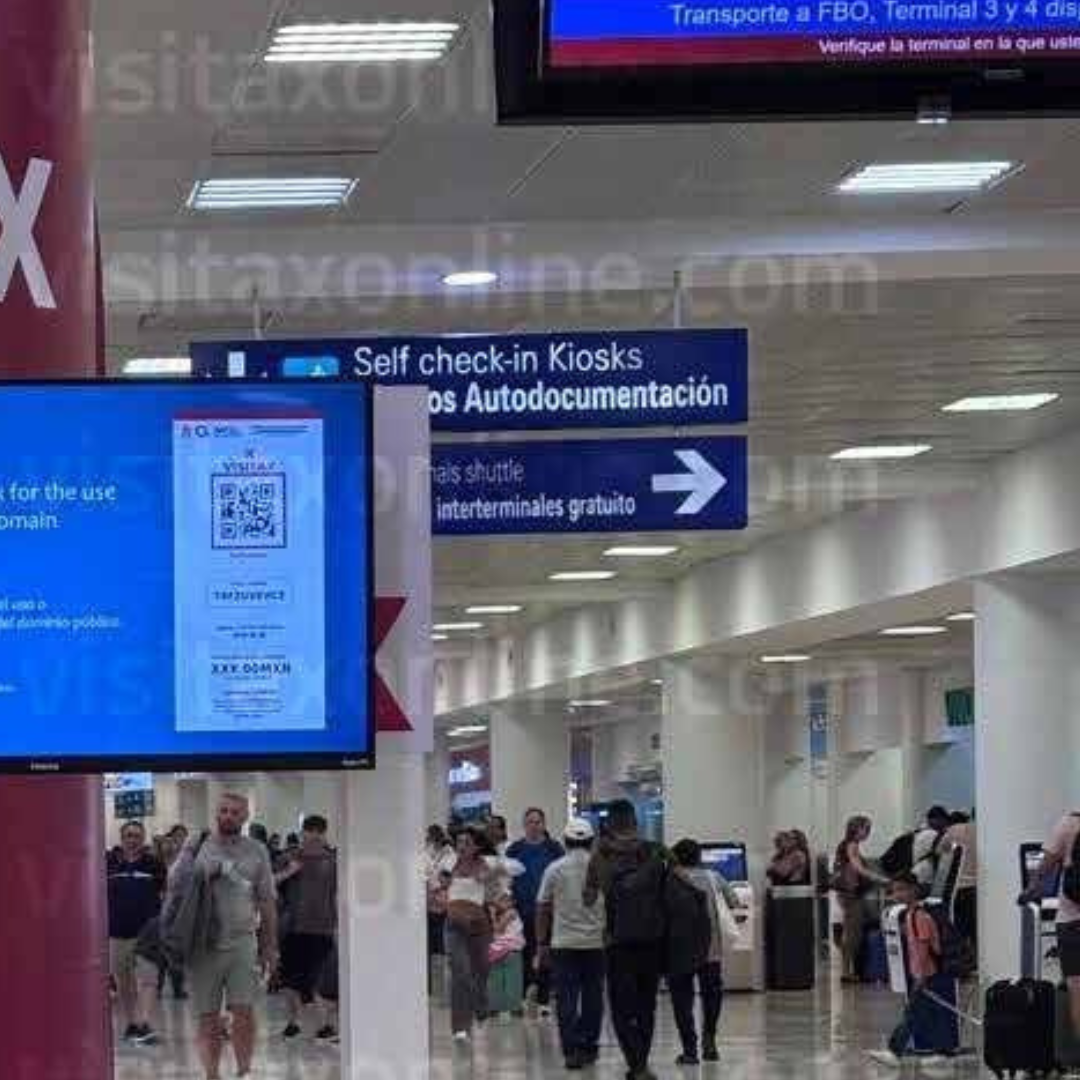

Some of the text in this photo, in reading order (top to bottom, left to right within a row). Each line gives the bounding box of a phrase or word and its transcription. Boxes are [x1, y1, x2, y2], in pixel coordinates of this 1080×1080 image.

[670, 0, 1080, 27] Transporte a FBO, Terminal 3 y 4 dis
[818, 37, 886, 56] Verifique
[890, 38, 903, 52] la
[909, 37, 970, 52] terminal
[974, 39, 994, 50] en
[998, 37, 1012, 50] la
[1016, 38, 1045, 54] que
[354, 341, 643, 376] Self check-in Kiosks
[464, 375, 728, 414] Autodocumentación
[466, 457, 525, 483] shuttle
[10, 482, 40, 501] for
[44, 482, 77, 501] the
[81, 486, 117, 501] use
[437, 491, 636, 522] interterminales gratuito
